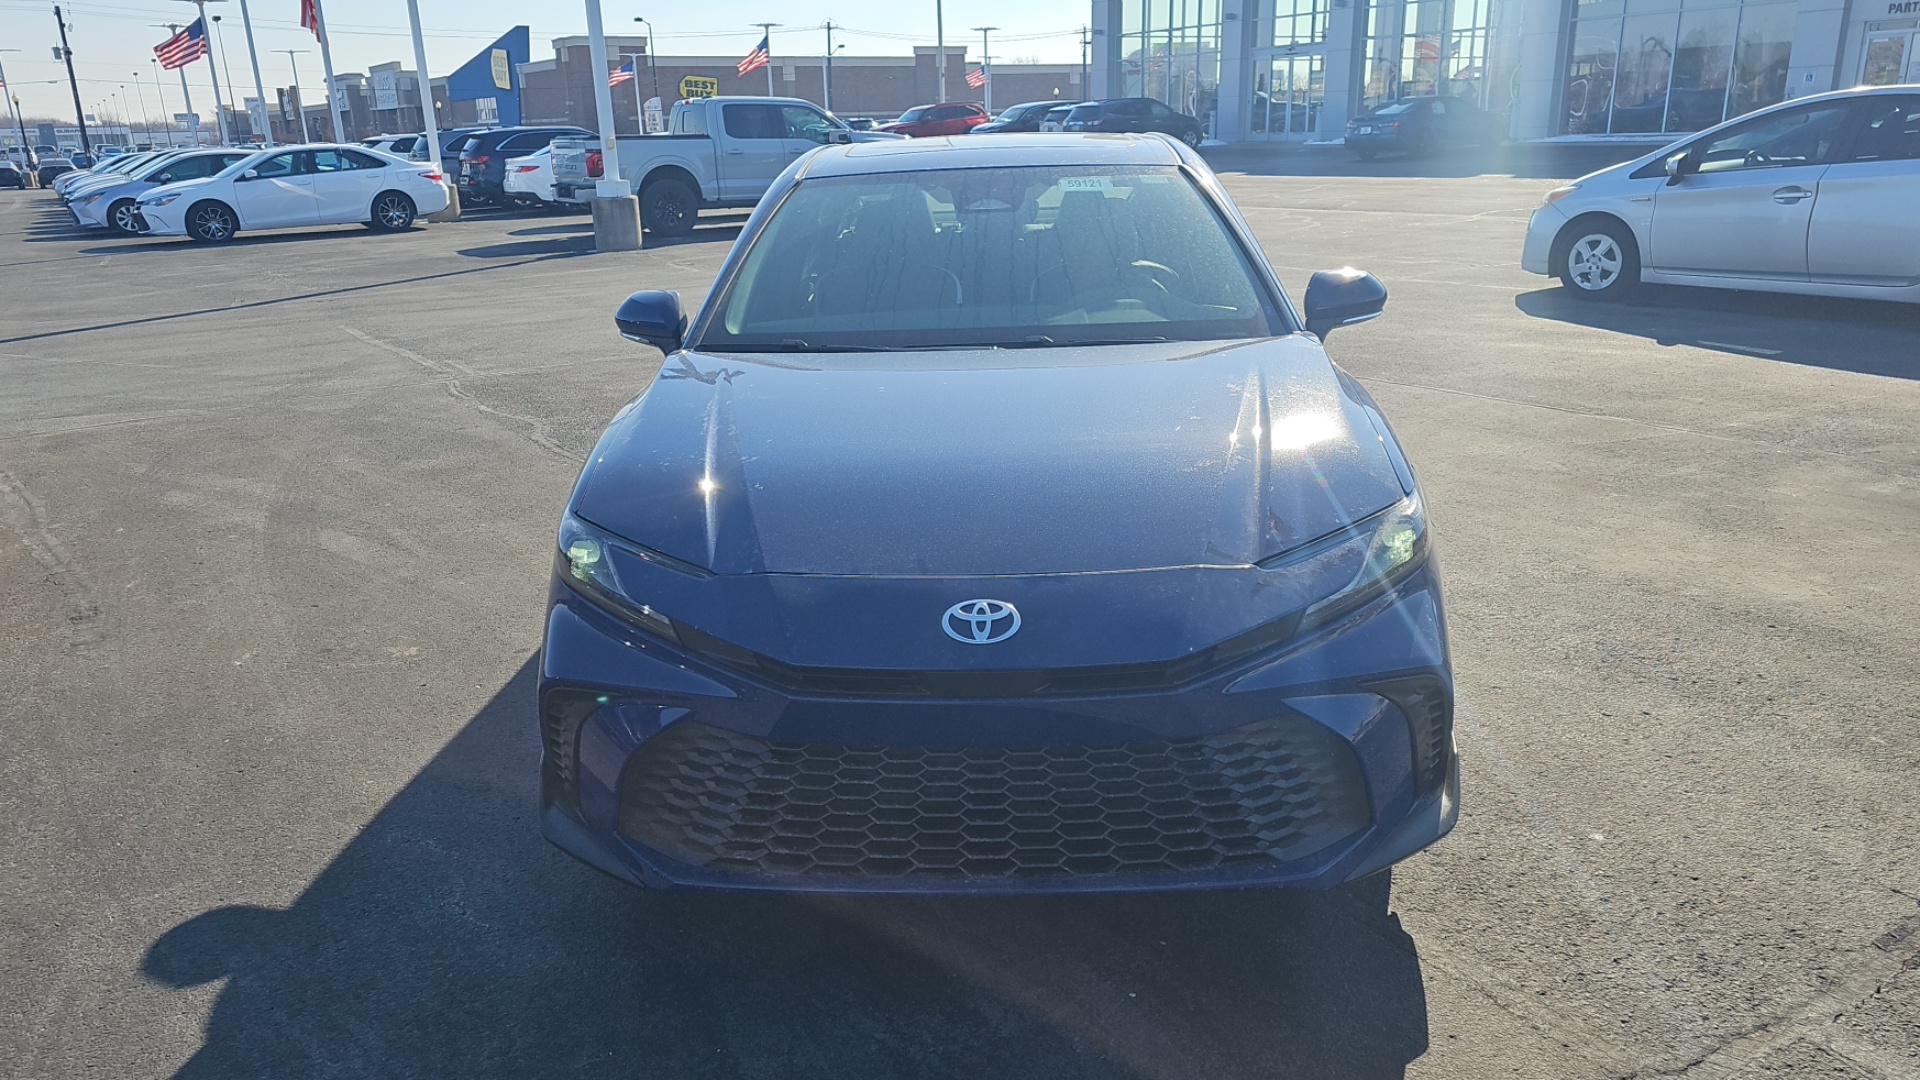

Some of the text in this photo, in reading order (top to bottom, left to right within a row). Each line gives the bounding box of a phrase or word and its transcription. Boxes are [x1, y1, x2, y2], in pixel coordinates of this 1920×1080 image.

[1888, 1, 1920, 14] PART
[492, 55, 507, 69] BEST
[684, 79, 716, 90] BEST
[686, 89, 713, 98] BUY
[1067, 179, 1103, 188] 59121
